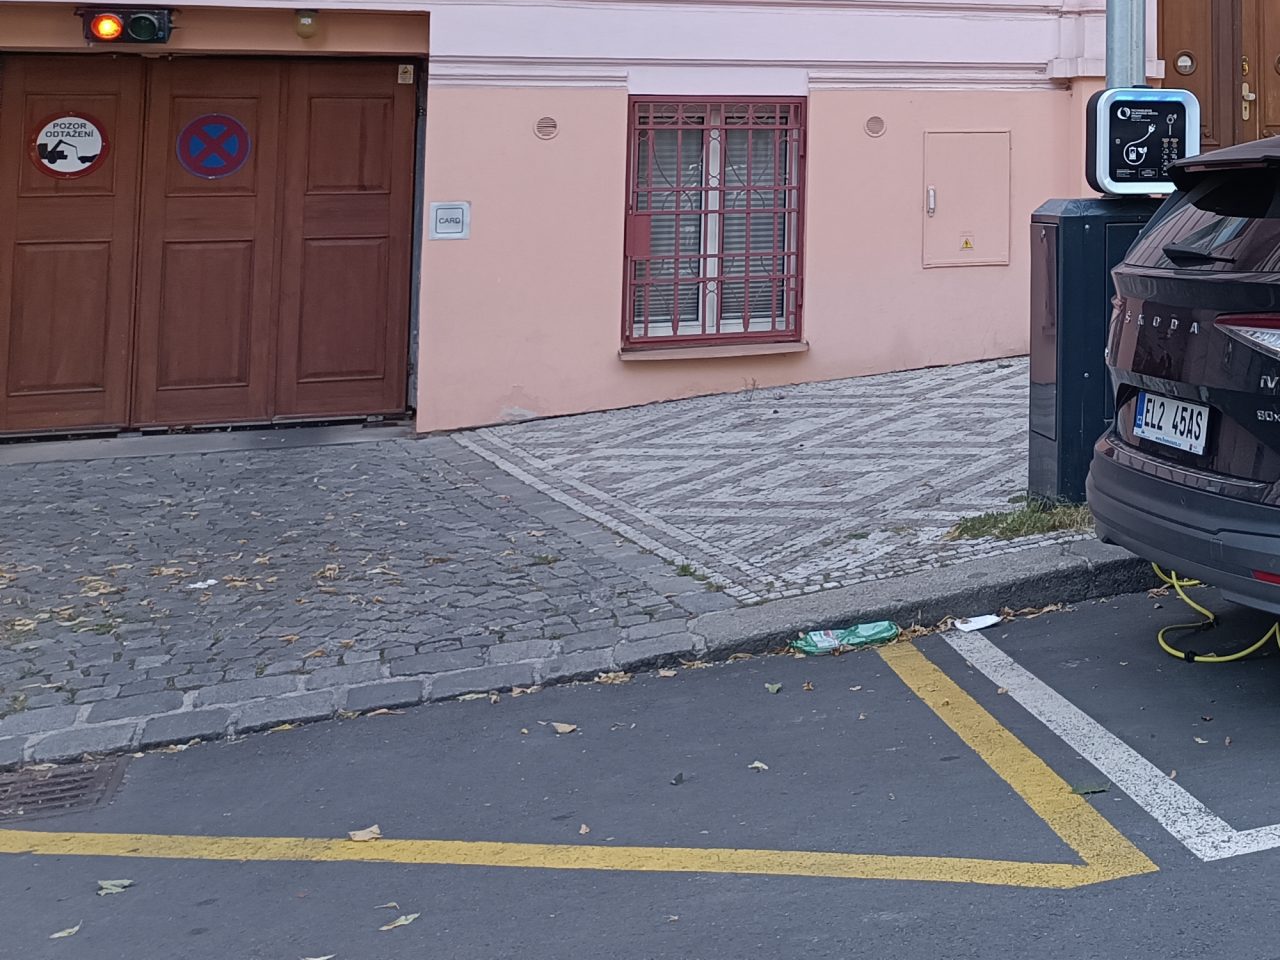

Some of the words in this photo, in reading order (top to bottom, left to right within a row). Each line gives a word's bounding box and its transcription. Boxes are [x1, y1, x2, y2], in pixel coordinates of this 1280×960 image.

[52, 122, 87, 130] POZOR
[45, 129, 94, 138] ODTAŽENÍ
[1144, 398, 1165, 431] EL2
[1172, 405, 1203, 441] 45AS
